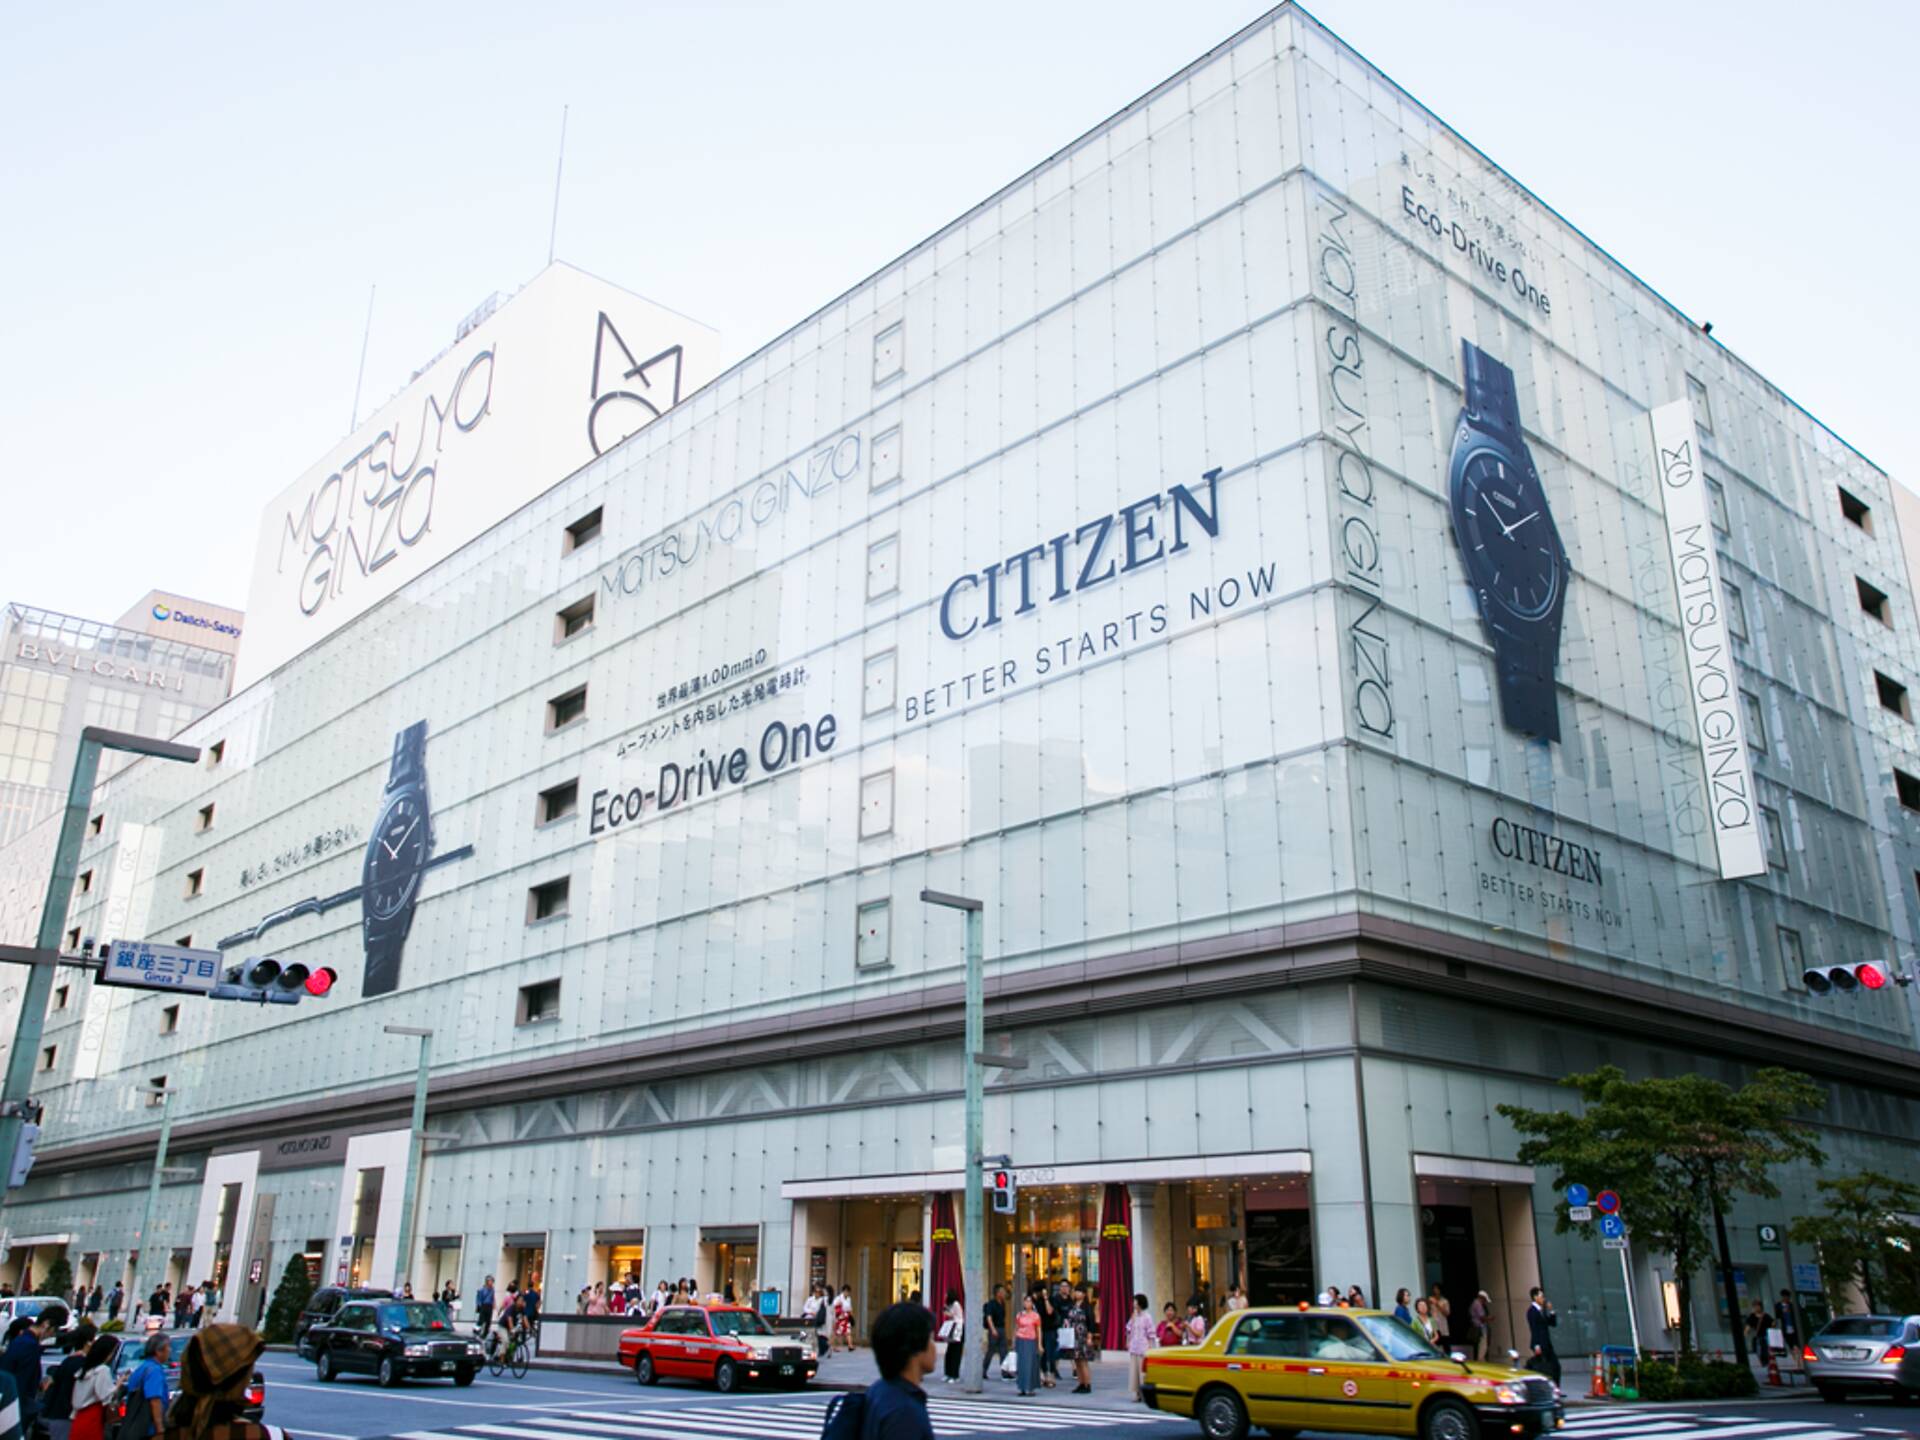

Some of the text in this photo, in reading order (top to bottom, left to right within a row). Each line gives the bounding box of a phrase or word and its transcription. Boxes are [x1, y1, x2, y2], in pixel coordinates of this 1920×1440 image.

[1401, 185, 1551, 314] Eco-Drive One
[939, 466, 1223, 641] CITIZEN
[905, 562, 1277, 722] BETTER STARTS NOW
[590, 713, 836, 835] Eco-Drive One
[1492, 817, 1603, 887] CITIZEN
[1481, 872, 1623, 929] BETTER STARTS NOW
[115, 950, 214, 977] 銀座三丁目
[143, 970, 172, 983] Ginza
